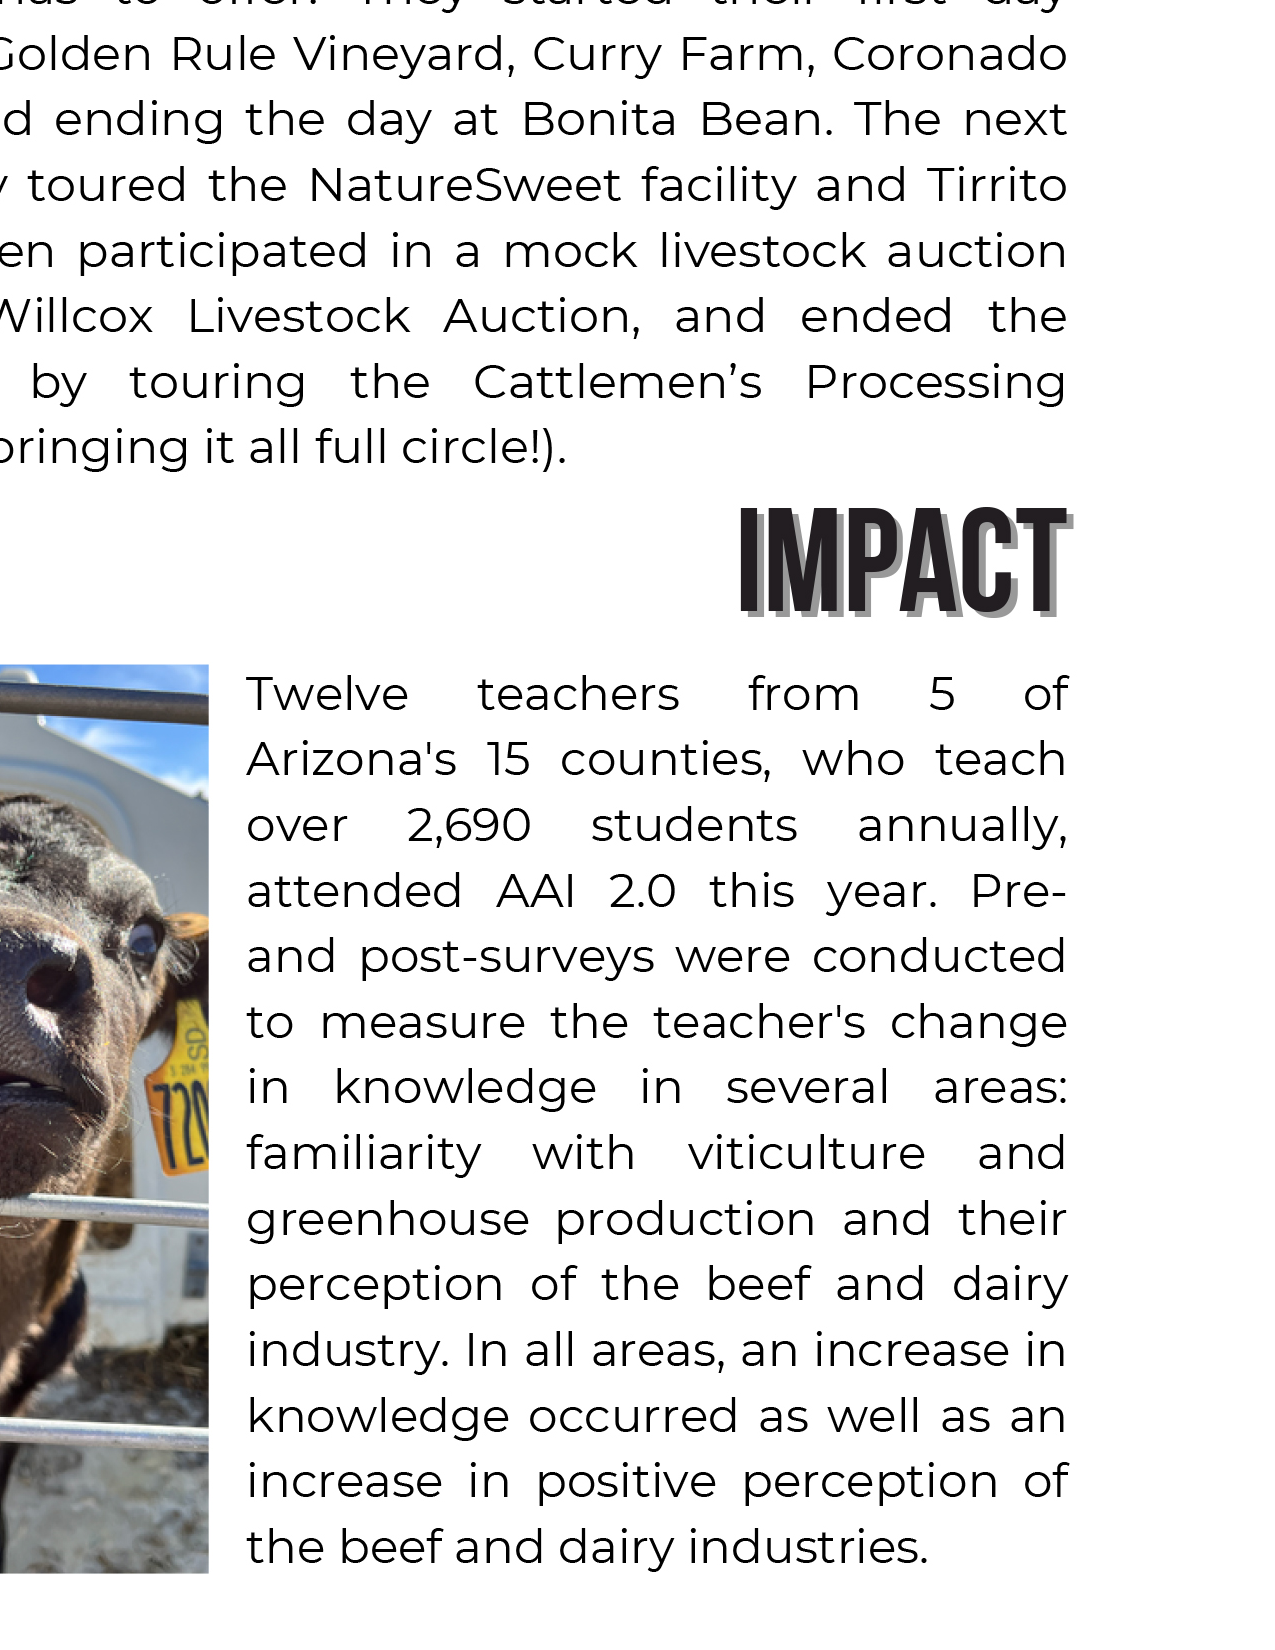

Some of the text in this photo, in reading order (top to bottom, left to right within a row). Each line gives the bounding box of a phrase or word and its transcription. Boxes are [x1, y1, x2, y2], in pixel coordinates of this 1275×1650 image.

[175, 35, 275, 70] Rule
[293, 35, 514, 79] Vineyard,
[535, 37, 662, 79] Curry
[684, 37, 814, 77] Farm,
[835, 35, 1066, 70] Coronado
[207, 428, 234, 463] it
[251, 428, 297, 463] all
[316, 428, 384, 463] full
[403, 428, 565, 472] circle!).
[741, 507, 1066, 612] IMPACT
[246, 740, 1063, 782] Arizona's 15 counties, who teach
[248, 806, 1065, 850] over 2,690 students annually,
[247, 1528, 926, 1572] the beef and dairy industries.
